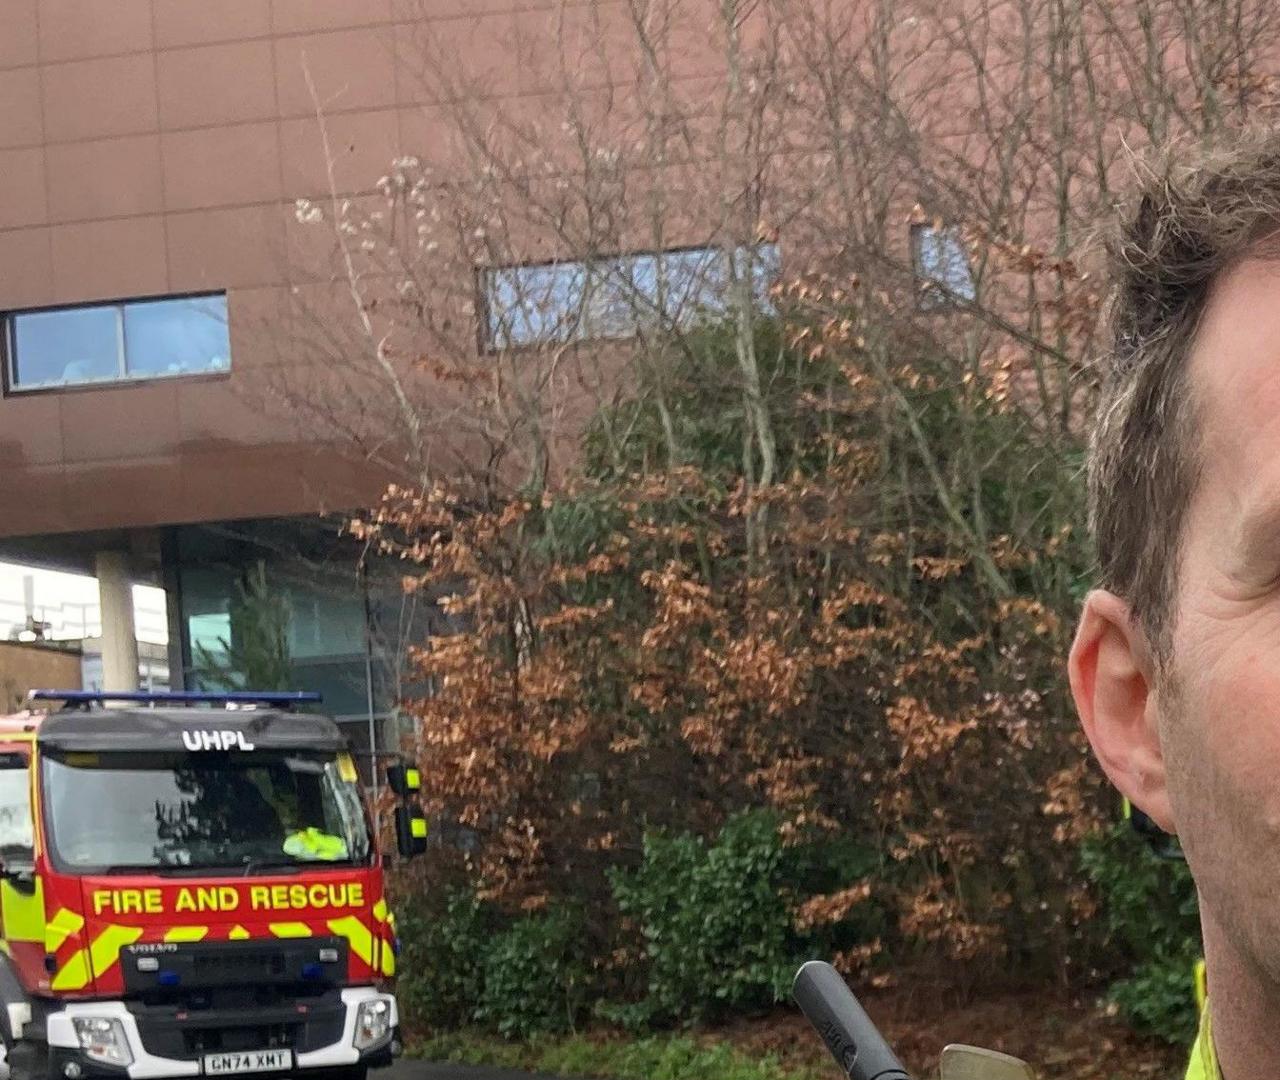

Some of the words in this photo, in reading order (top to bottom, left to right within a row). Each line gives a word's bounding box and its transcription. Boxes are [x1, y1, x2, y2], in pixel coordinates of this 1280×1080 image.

[183, 730, 254, 752] UHPL
[94, 889, 162, 914] FIRE
[176, 887, 239, 912] AND
[251, 883, 364, 909] RESCUE
[211, 1053, 250, 1070] GN74
[257, 1051, 286, 1067] XMT
